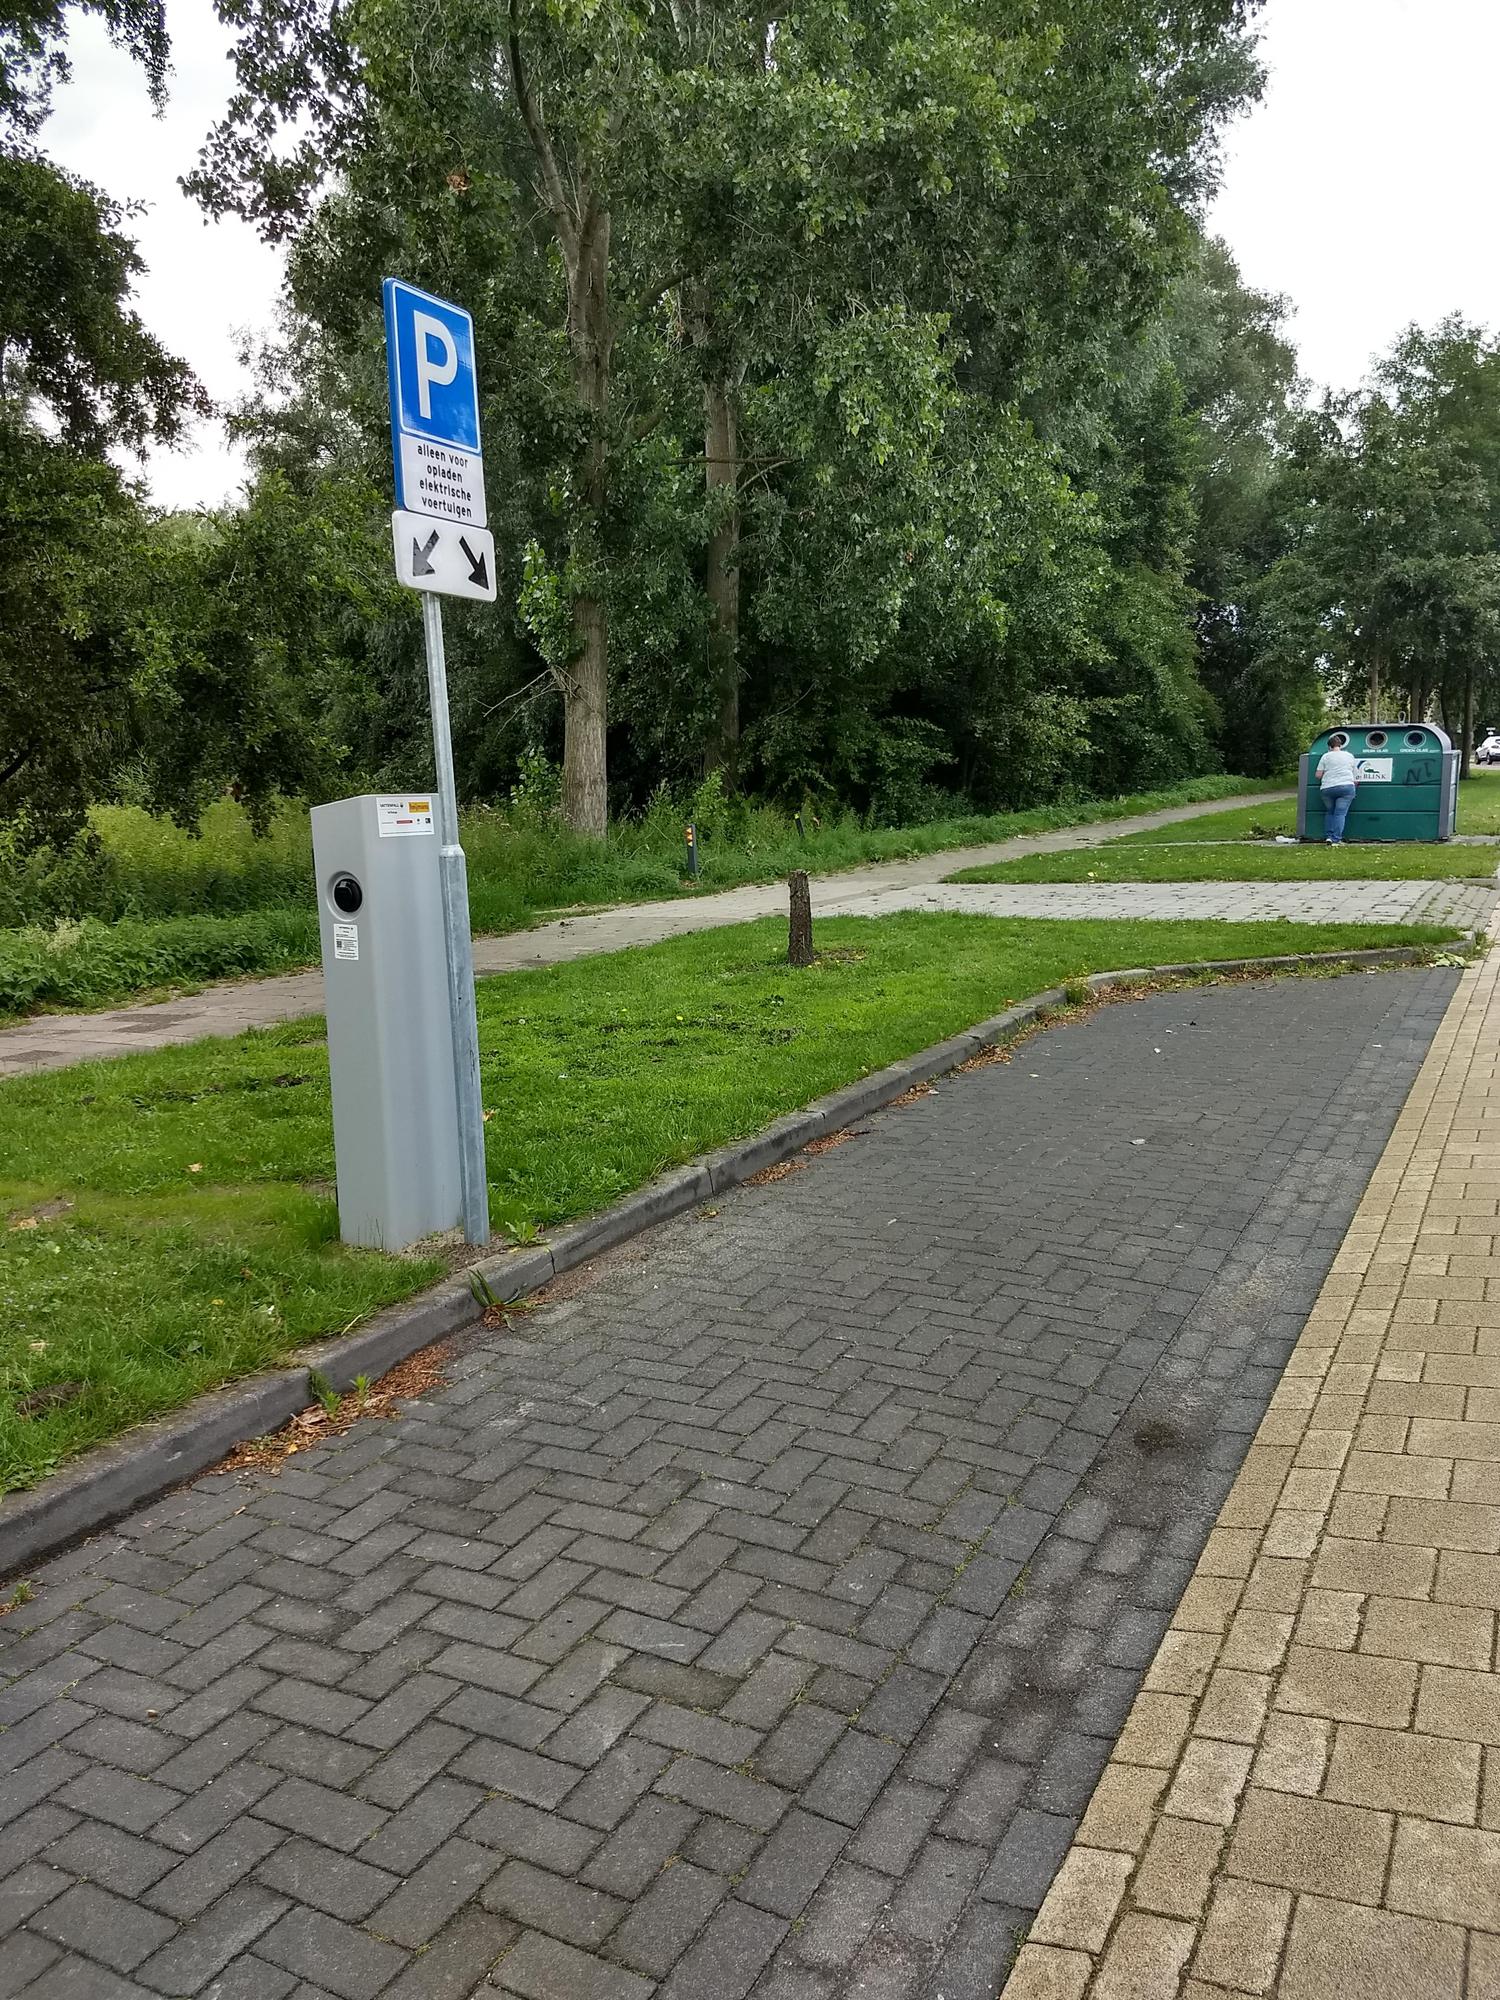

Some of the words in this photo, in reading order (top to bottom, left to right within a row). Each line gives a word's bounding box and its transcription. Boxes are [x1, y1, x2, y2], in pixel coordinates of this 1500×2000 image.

[413, 309, 458, 420] P
[417, 444, 446, 462] alleen
[449, 454, 468, 468] voor
[427, 464, 463, 483] opladen
[419, 478, 472, 501] elektrische
[421, 496, 472, 518] voertuigen
